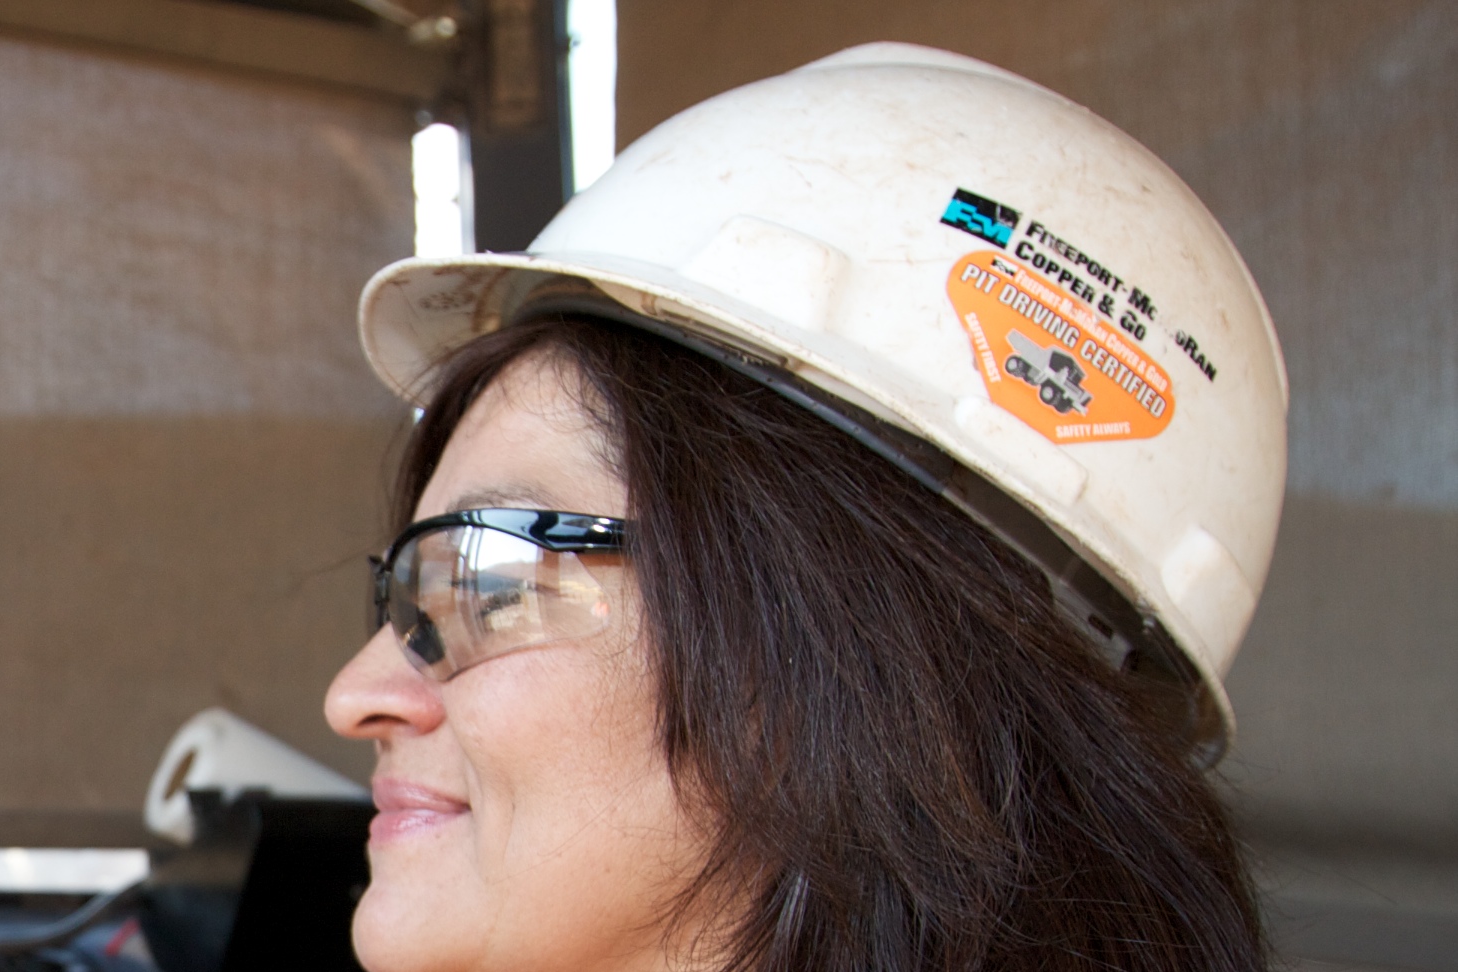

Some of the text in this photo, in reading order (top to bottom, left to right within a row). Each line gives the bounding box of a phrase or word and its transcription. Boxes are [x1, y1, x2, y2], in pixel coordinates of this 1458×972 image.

[1015, 240, 1096, 304] COPPER
[1098, 293, 1115, 320] &
[960, 262, 1167, 419] PIT DRIVING CERTIFIED
[964, 311, 1002, 384] SAFETY FIRST
[1055, 421, 1131, 439] SAFETY ALWAYS
